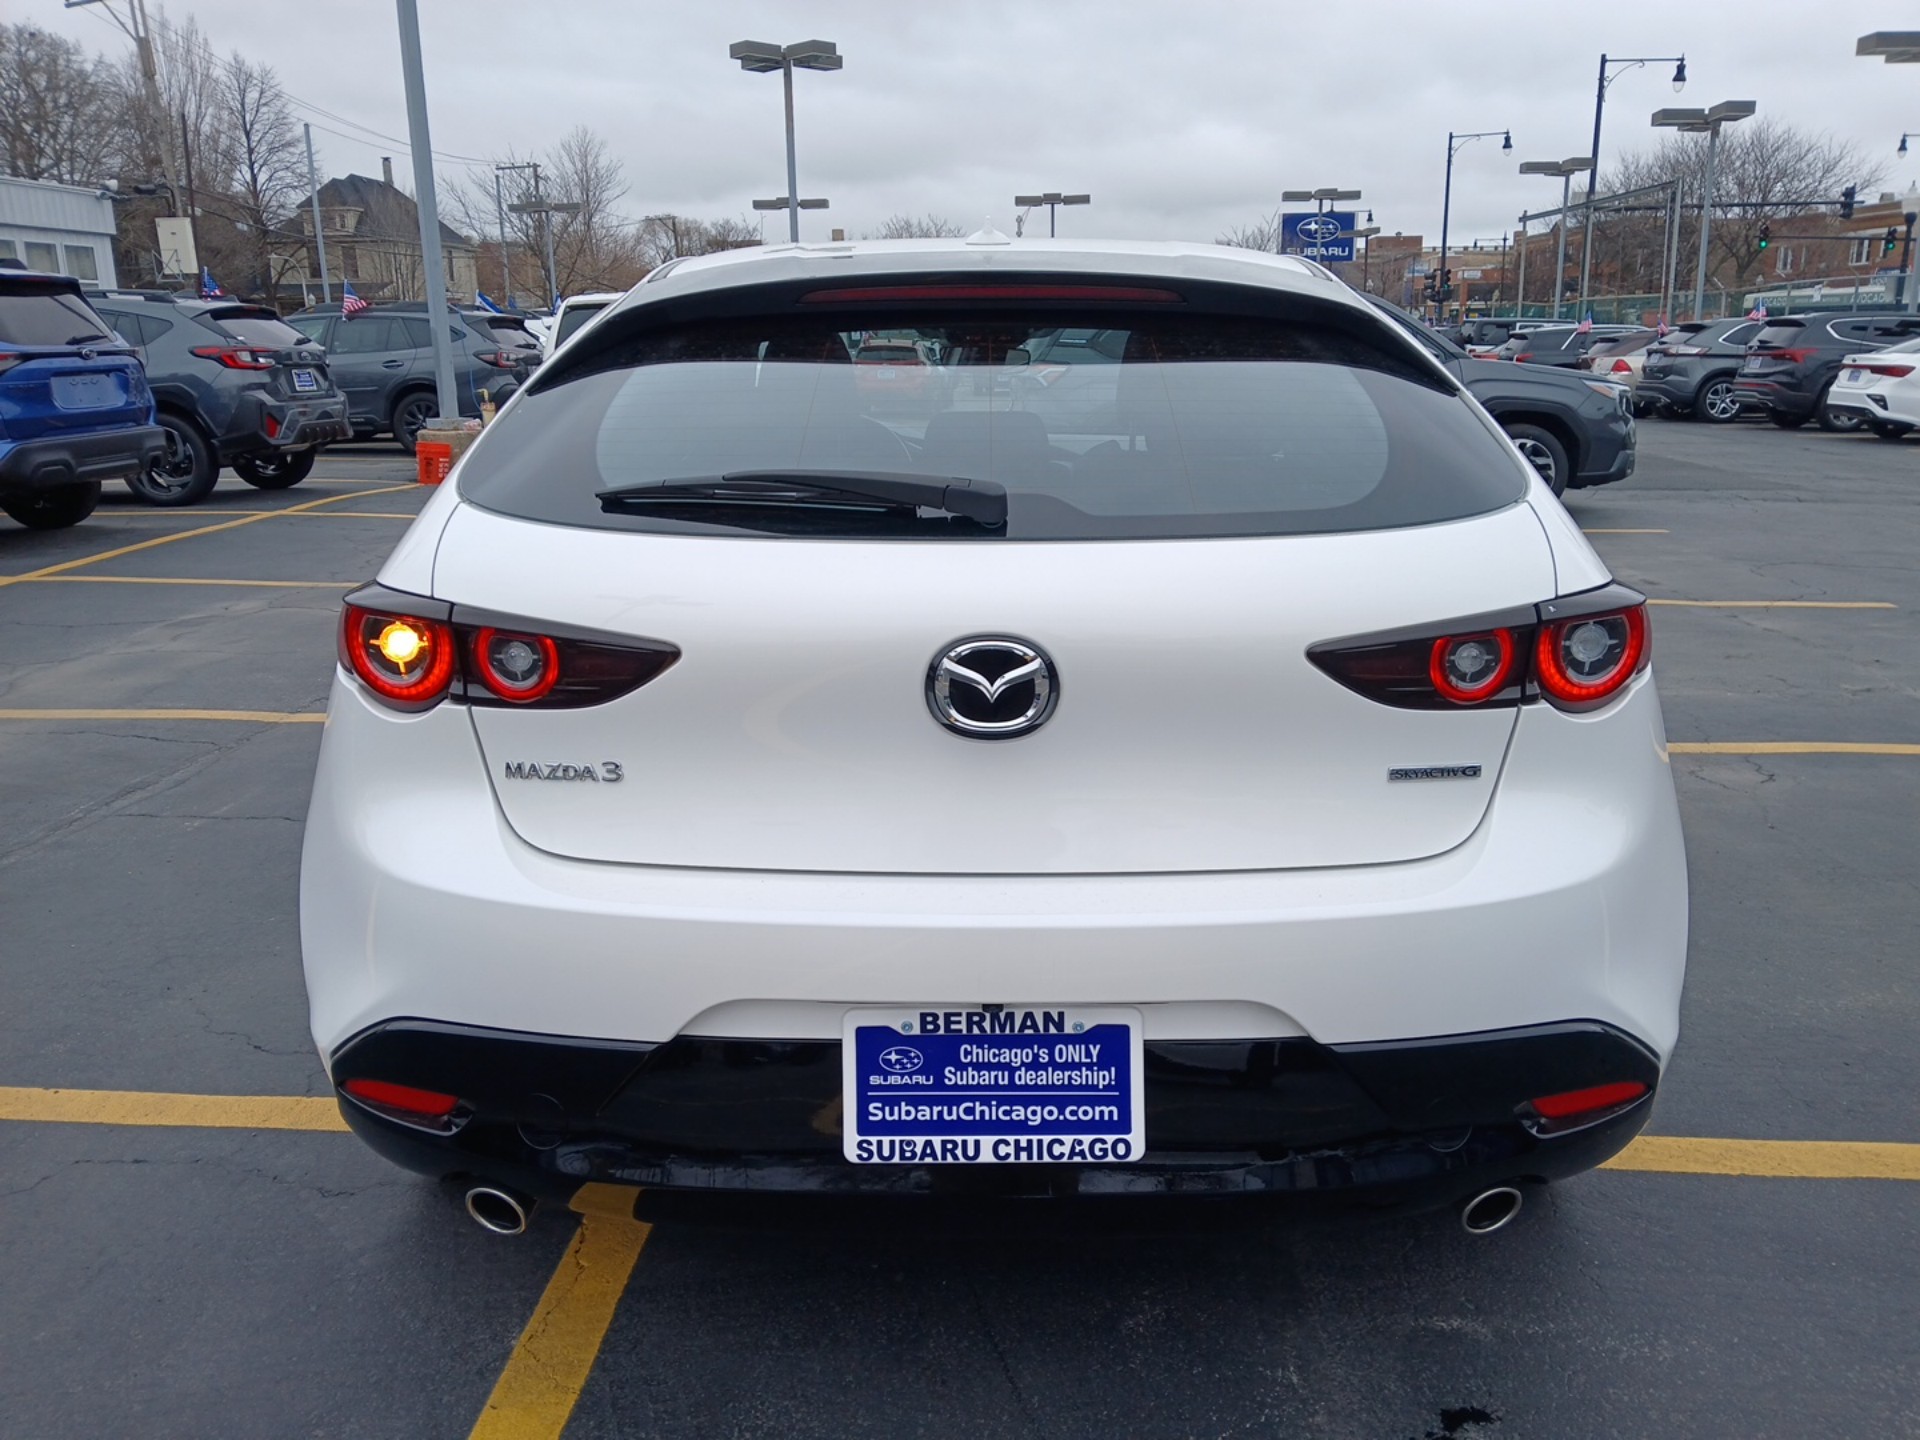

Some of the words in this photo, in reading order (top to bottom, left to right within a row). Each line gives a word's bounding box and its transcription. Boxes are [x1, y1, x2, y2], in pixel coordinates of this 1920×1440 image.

[1287, 246, 1349, 256] SUBARU
[919, 1011, 1065, 1034] BERMAN
[959, 1044, 1049, 1065] Chicago's
[1054, 1043, 1101, 1063] ONLY
[869, 1075, 934, 1085] SUBARU
[943, 1066, 1009, 1086] Subaru
[1014, 1066, 1116, 1090] dealership!
[867, 1100, 1118, 1126] SubaruChicago.com
[856, 1138, 980, 1162] SUBARU
[991, 1137, 1132, 1161] CHICAGO
